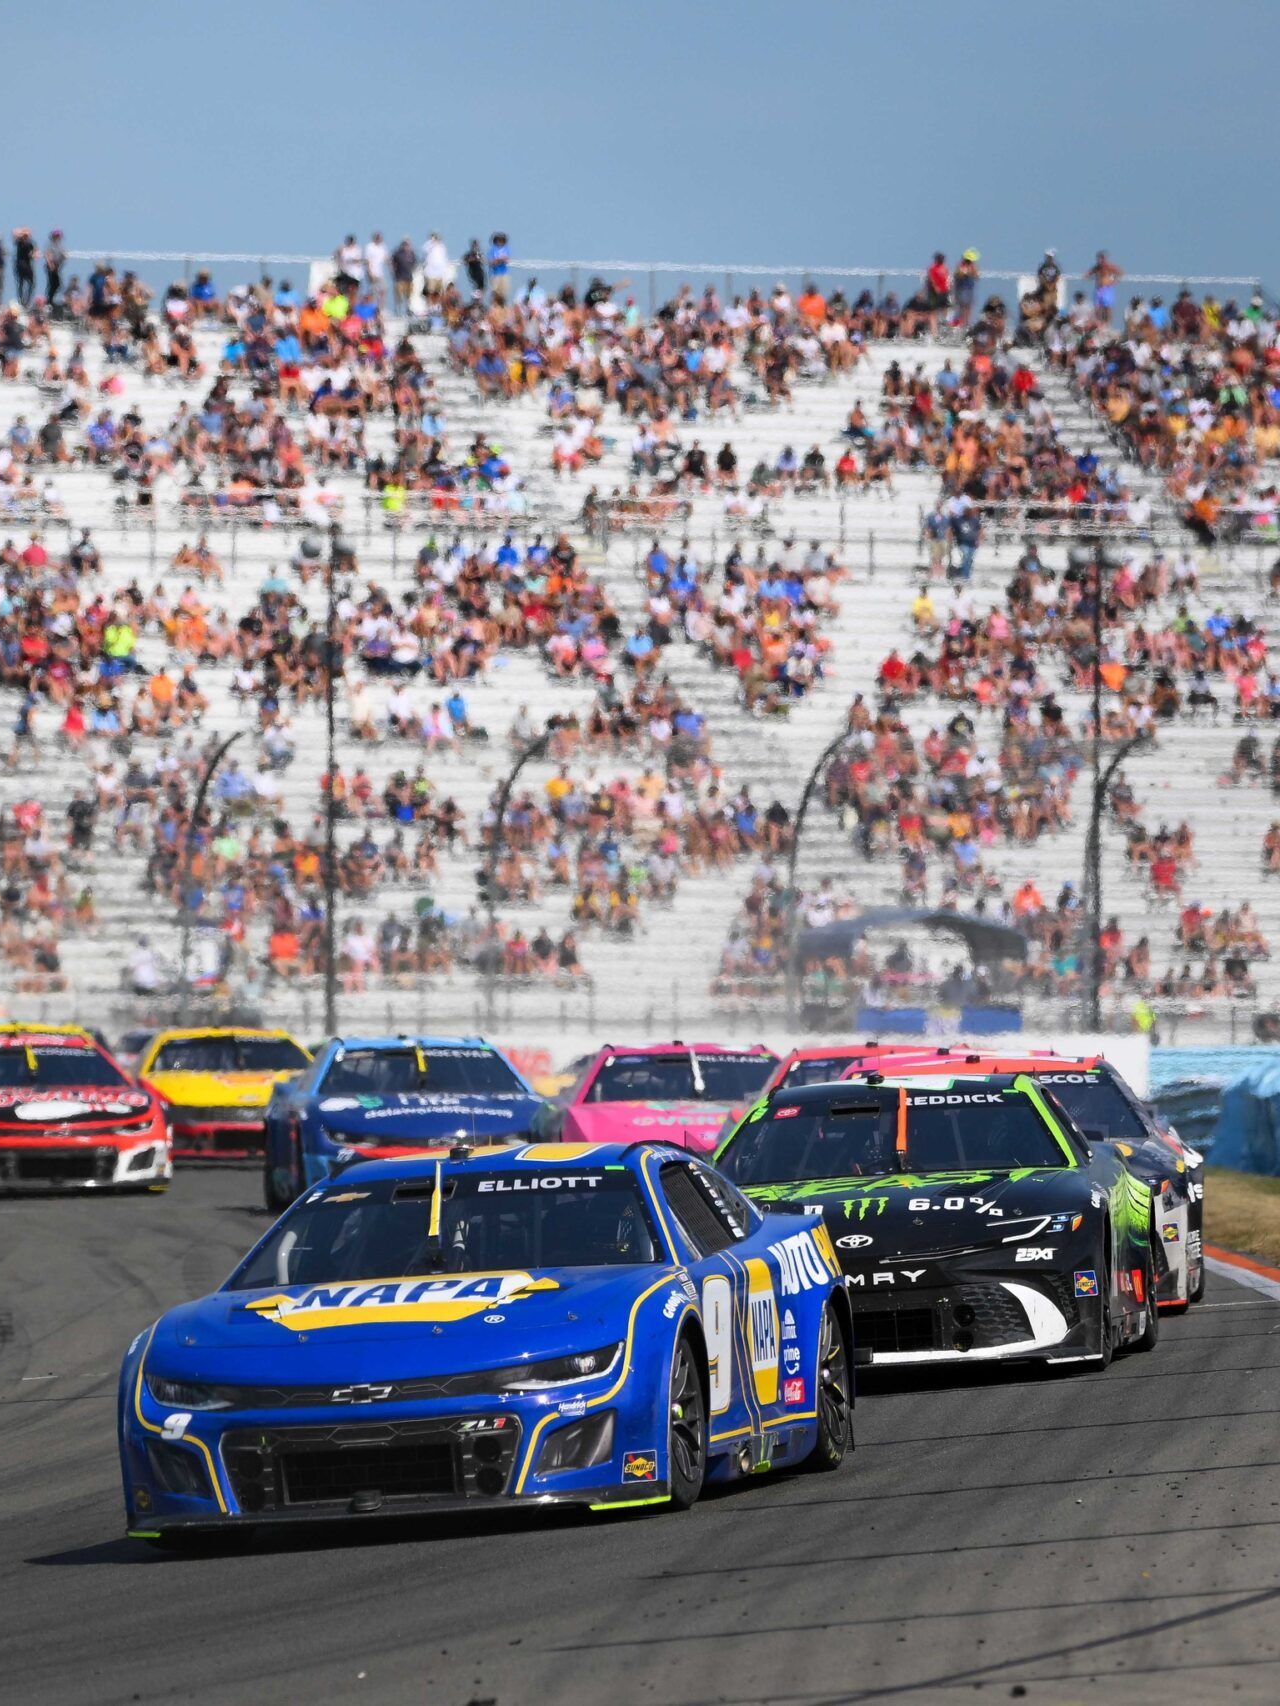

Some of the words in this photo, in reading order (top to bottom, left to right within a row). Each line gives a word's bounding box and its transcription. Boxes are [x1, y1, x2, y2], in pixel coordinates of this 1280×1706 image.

[1039, 1073, 1100, 1084] SCOE
[477, 1176, 603, 1192] ELLIOTT
[907, 1196, 1004, 1217] 6.0%
[767, 1231, 829, 1297] AUTO
[293, 1277, 505, 1310] NAPA
[751, 1299, 777, 1363] NAPA
[702, 1275, 732, 1416] 9
[161, 1413, 193, 1440] 9
[457, 1418, 507, 1433] ZL1
[626, 1462, 655, 1472] SUNOCO
